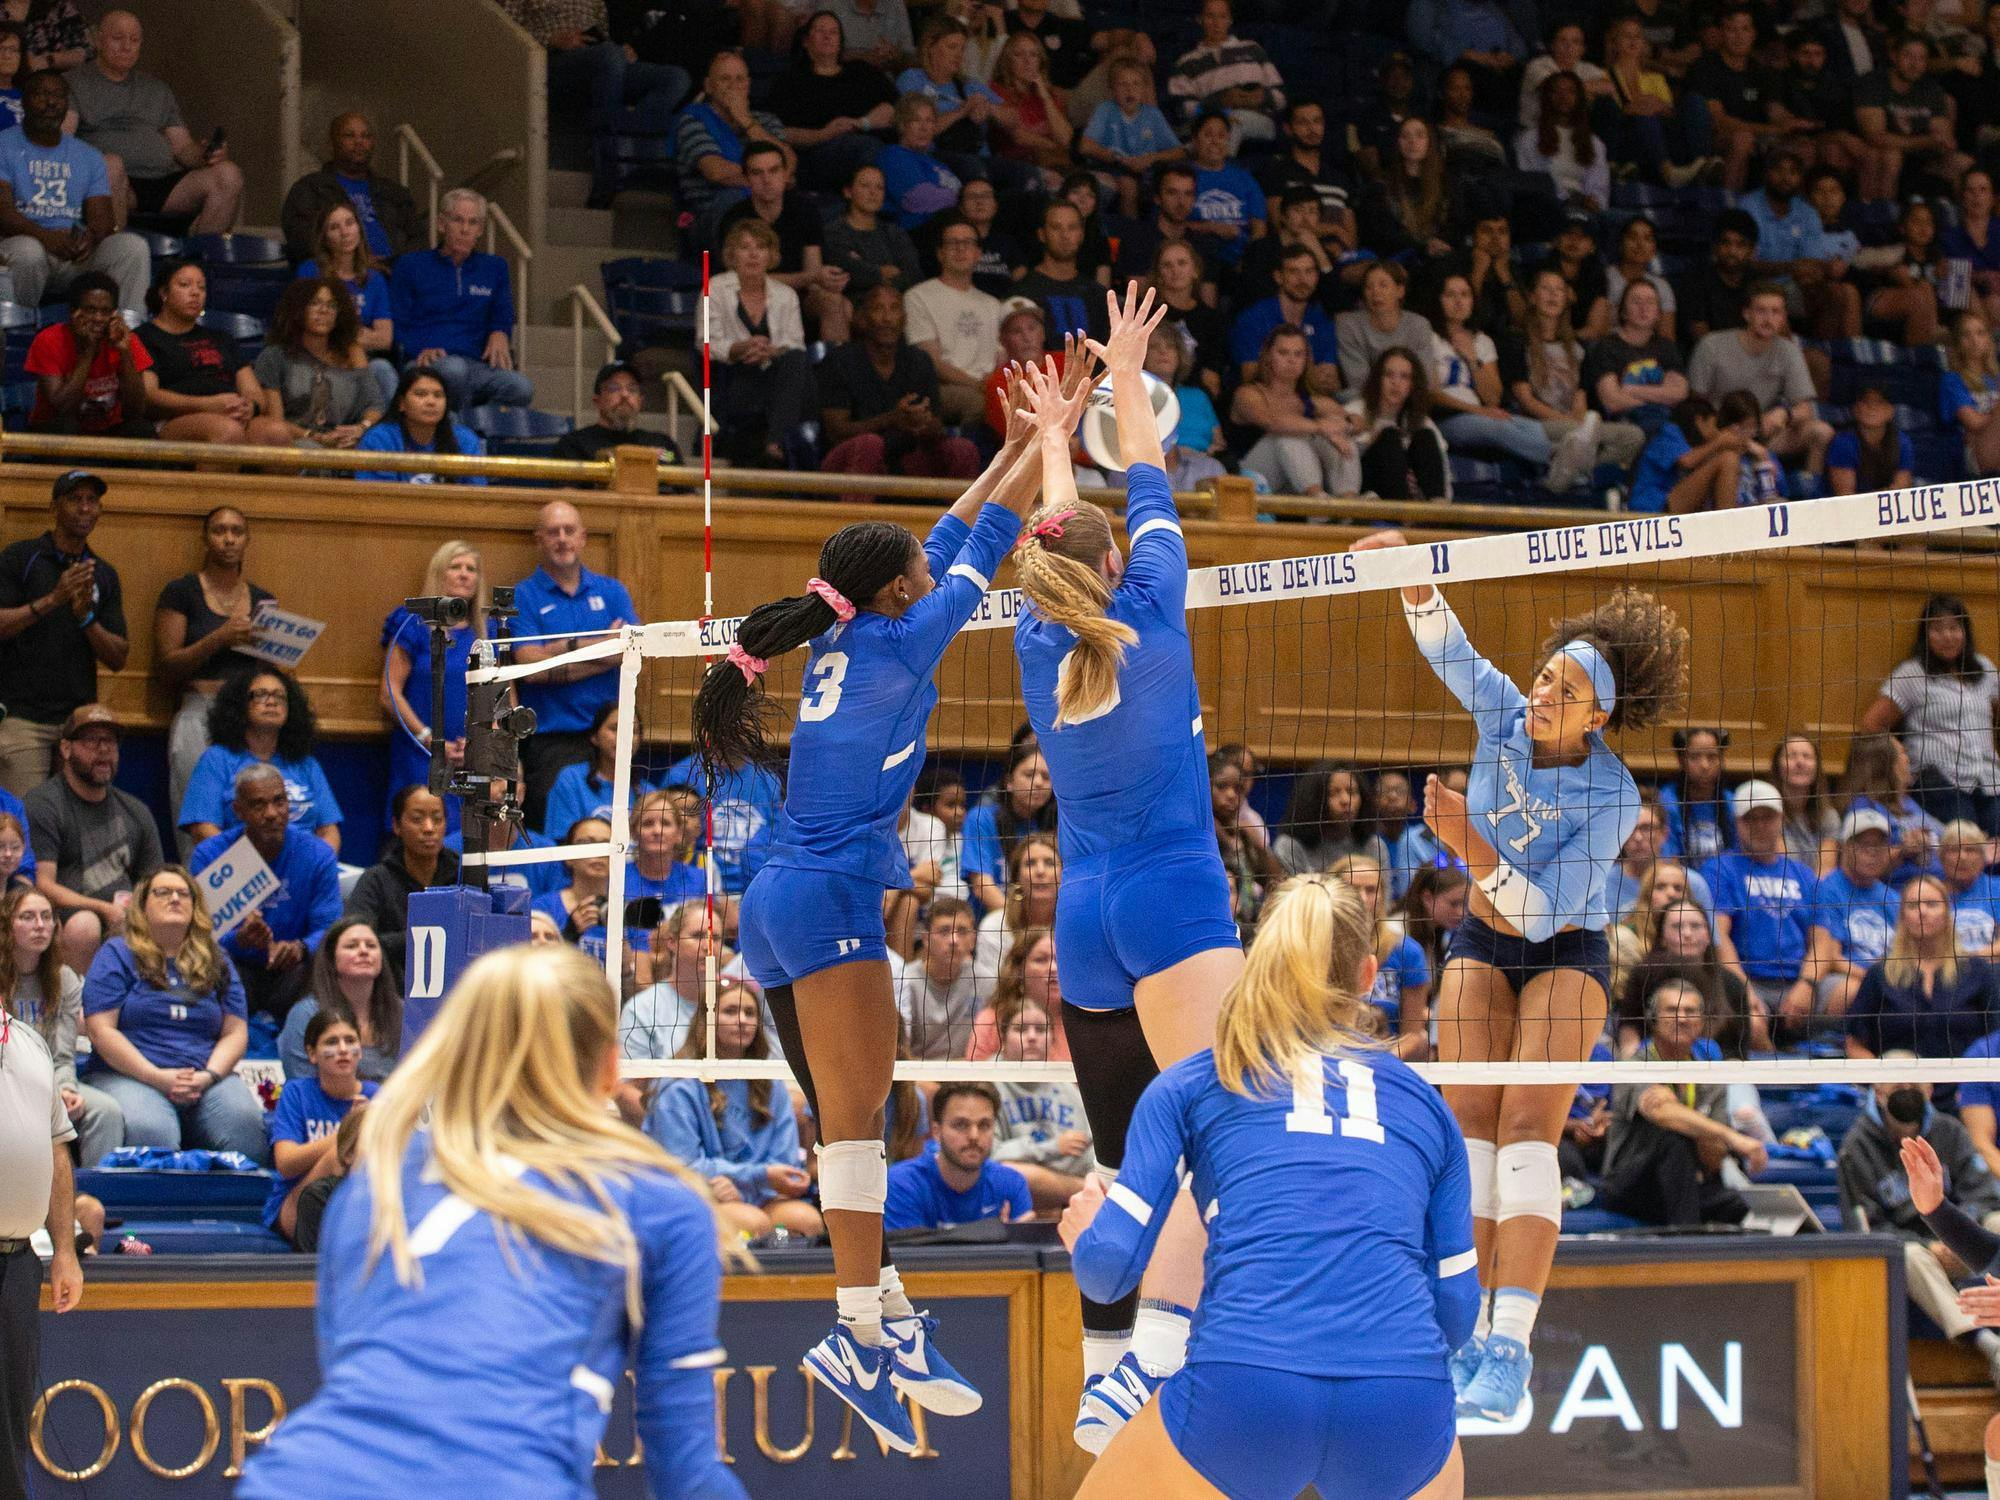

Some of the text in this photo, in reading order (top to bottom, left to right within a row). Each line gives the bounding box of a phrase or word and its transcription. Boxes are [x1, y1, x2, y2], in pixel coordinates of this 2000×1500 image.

[32, 178, 67, 208] 23
[1878, 479, 2000, 526] BLUE DE
[1527, 517, 1683, 564] BLUE DEVILS
[1219, 554, 1356, 596] BLUE DEVILS
[800, 651, 850, 722] 3
[209, 863, 234, 889] GO
[212, 869, 272, 931] DUKE!!!
[1285, 1053, 1386, 1145] 11
